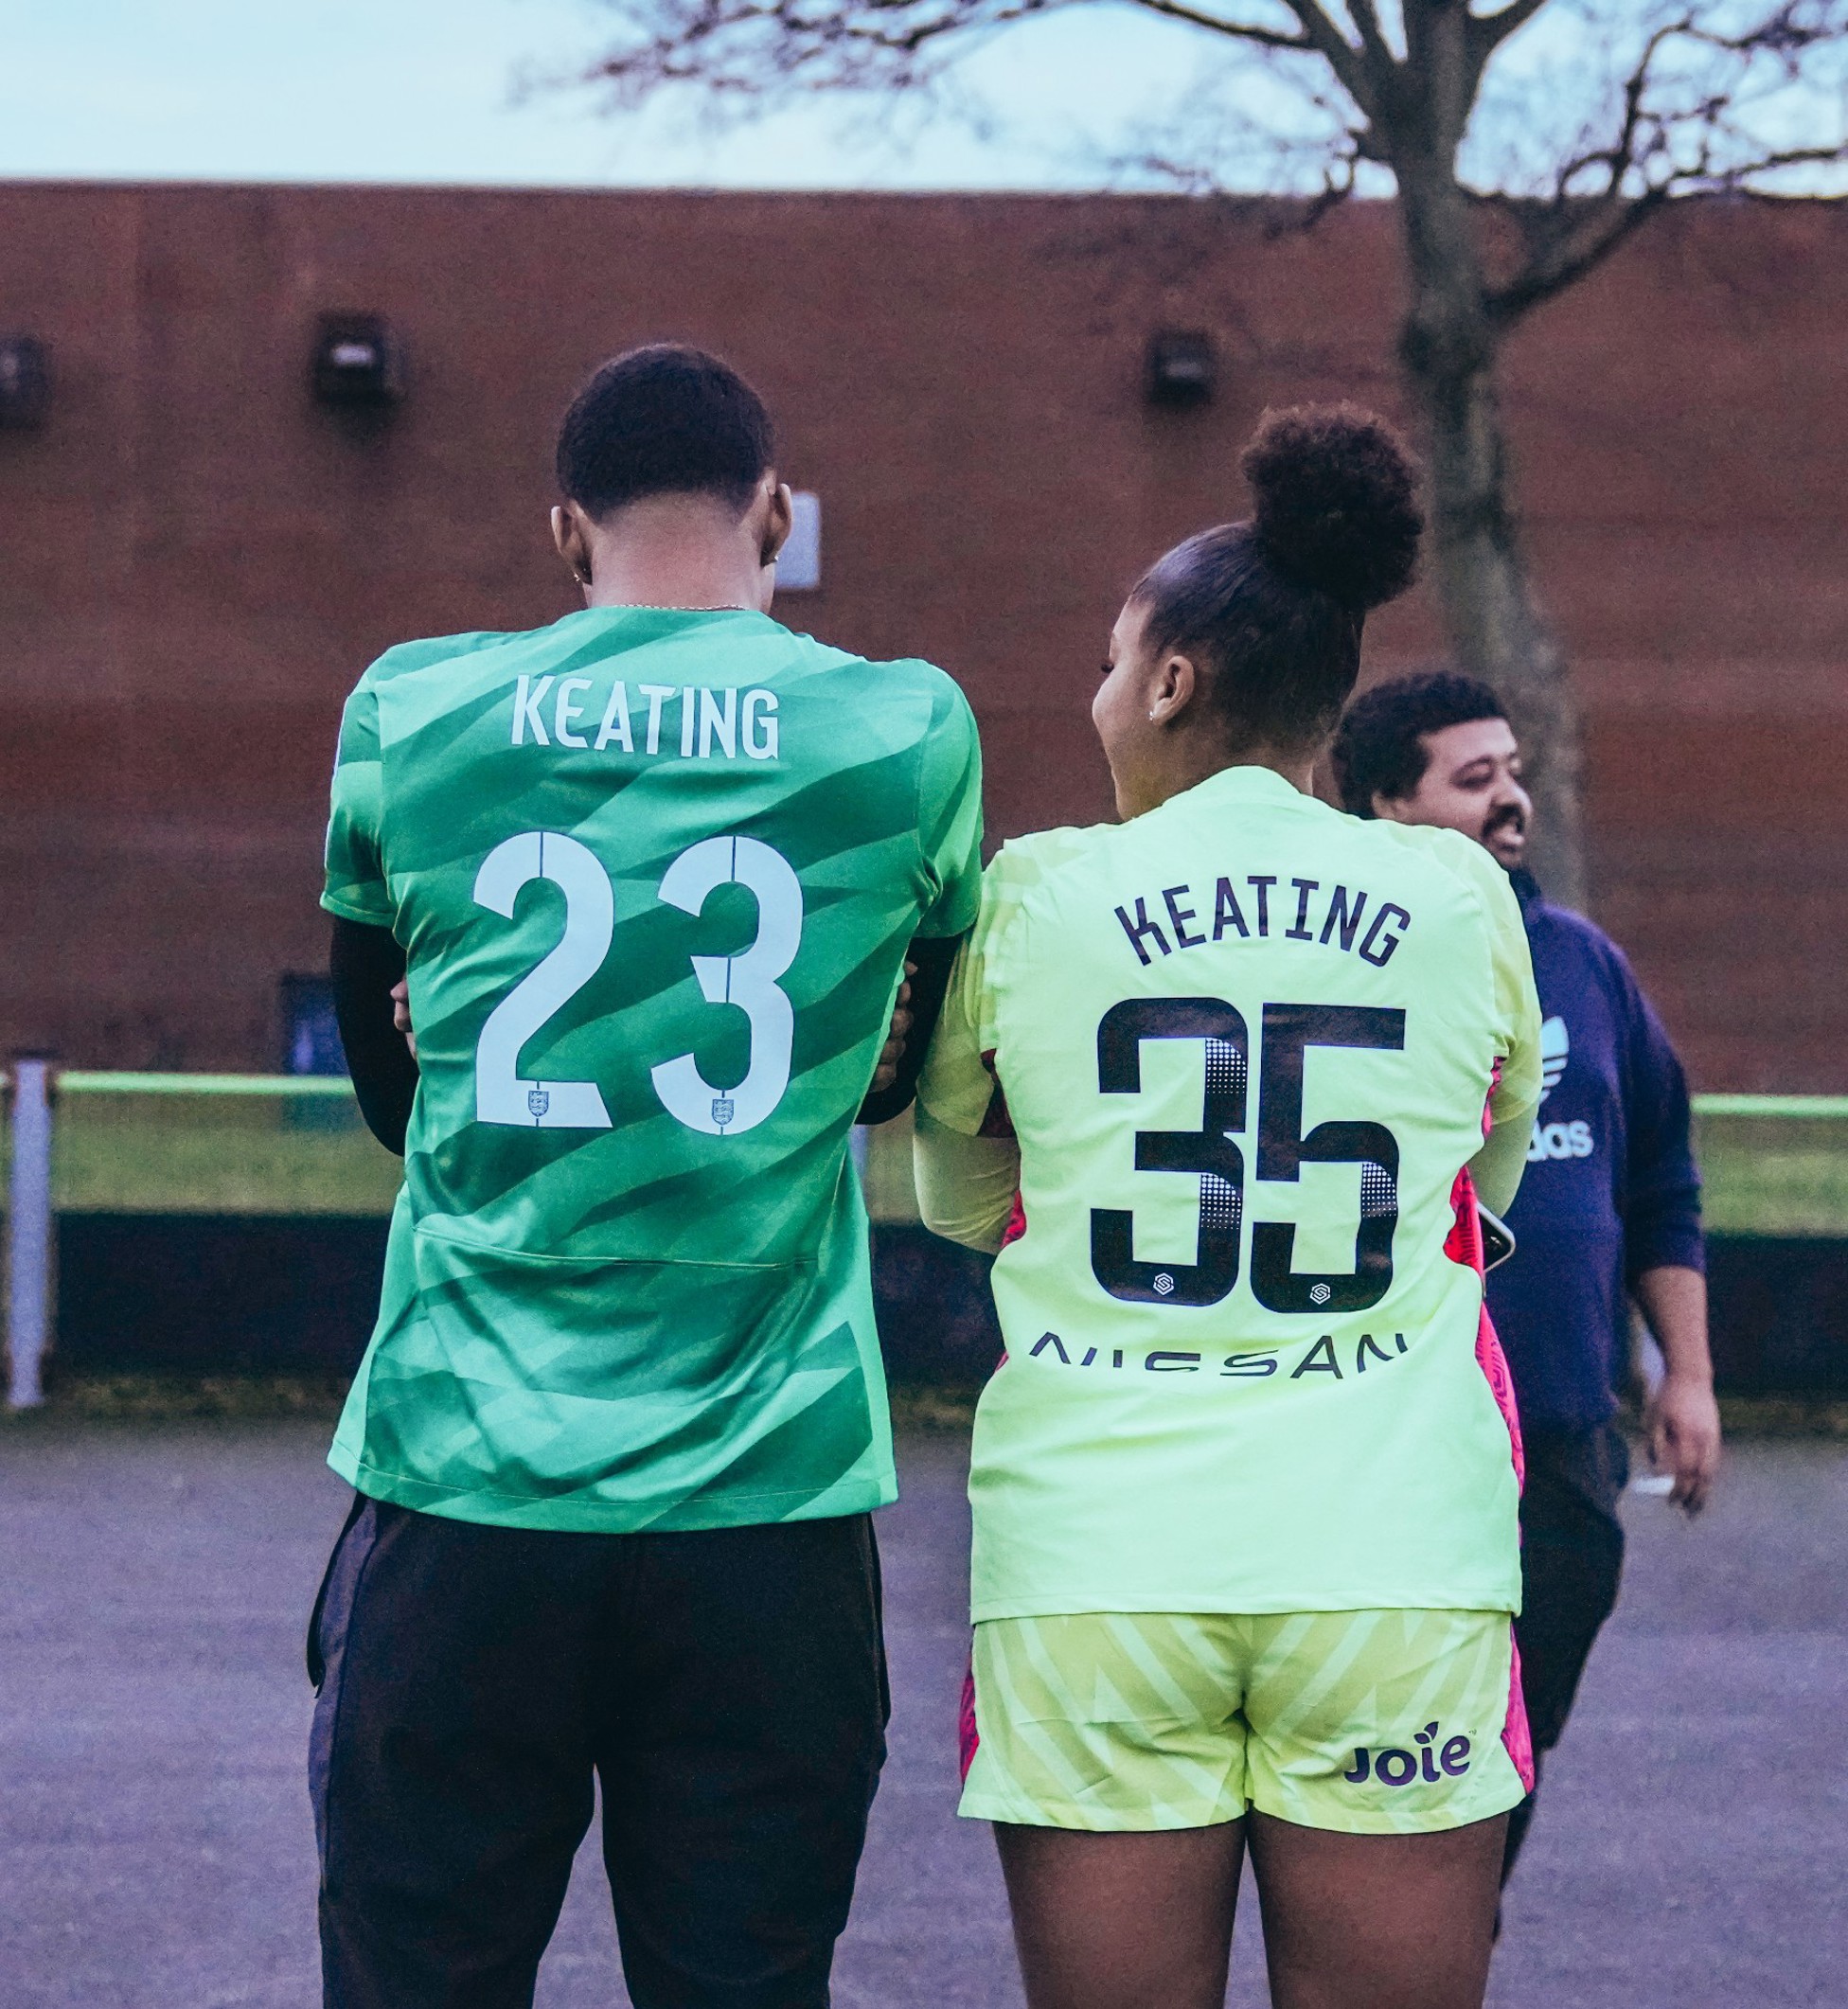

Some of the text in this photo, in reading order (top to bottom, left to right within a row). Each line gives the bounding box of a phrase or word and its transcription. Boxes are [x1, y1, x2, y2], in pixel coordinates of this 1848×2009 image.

[511, 673, 779, 759] KEATING
[473, 831, 805, 1135] 23
[1114, 875, 1411, 967] KEATING
[1090, 996, 1407, 1314] 35
